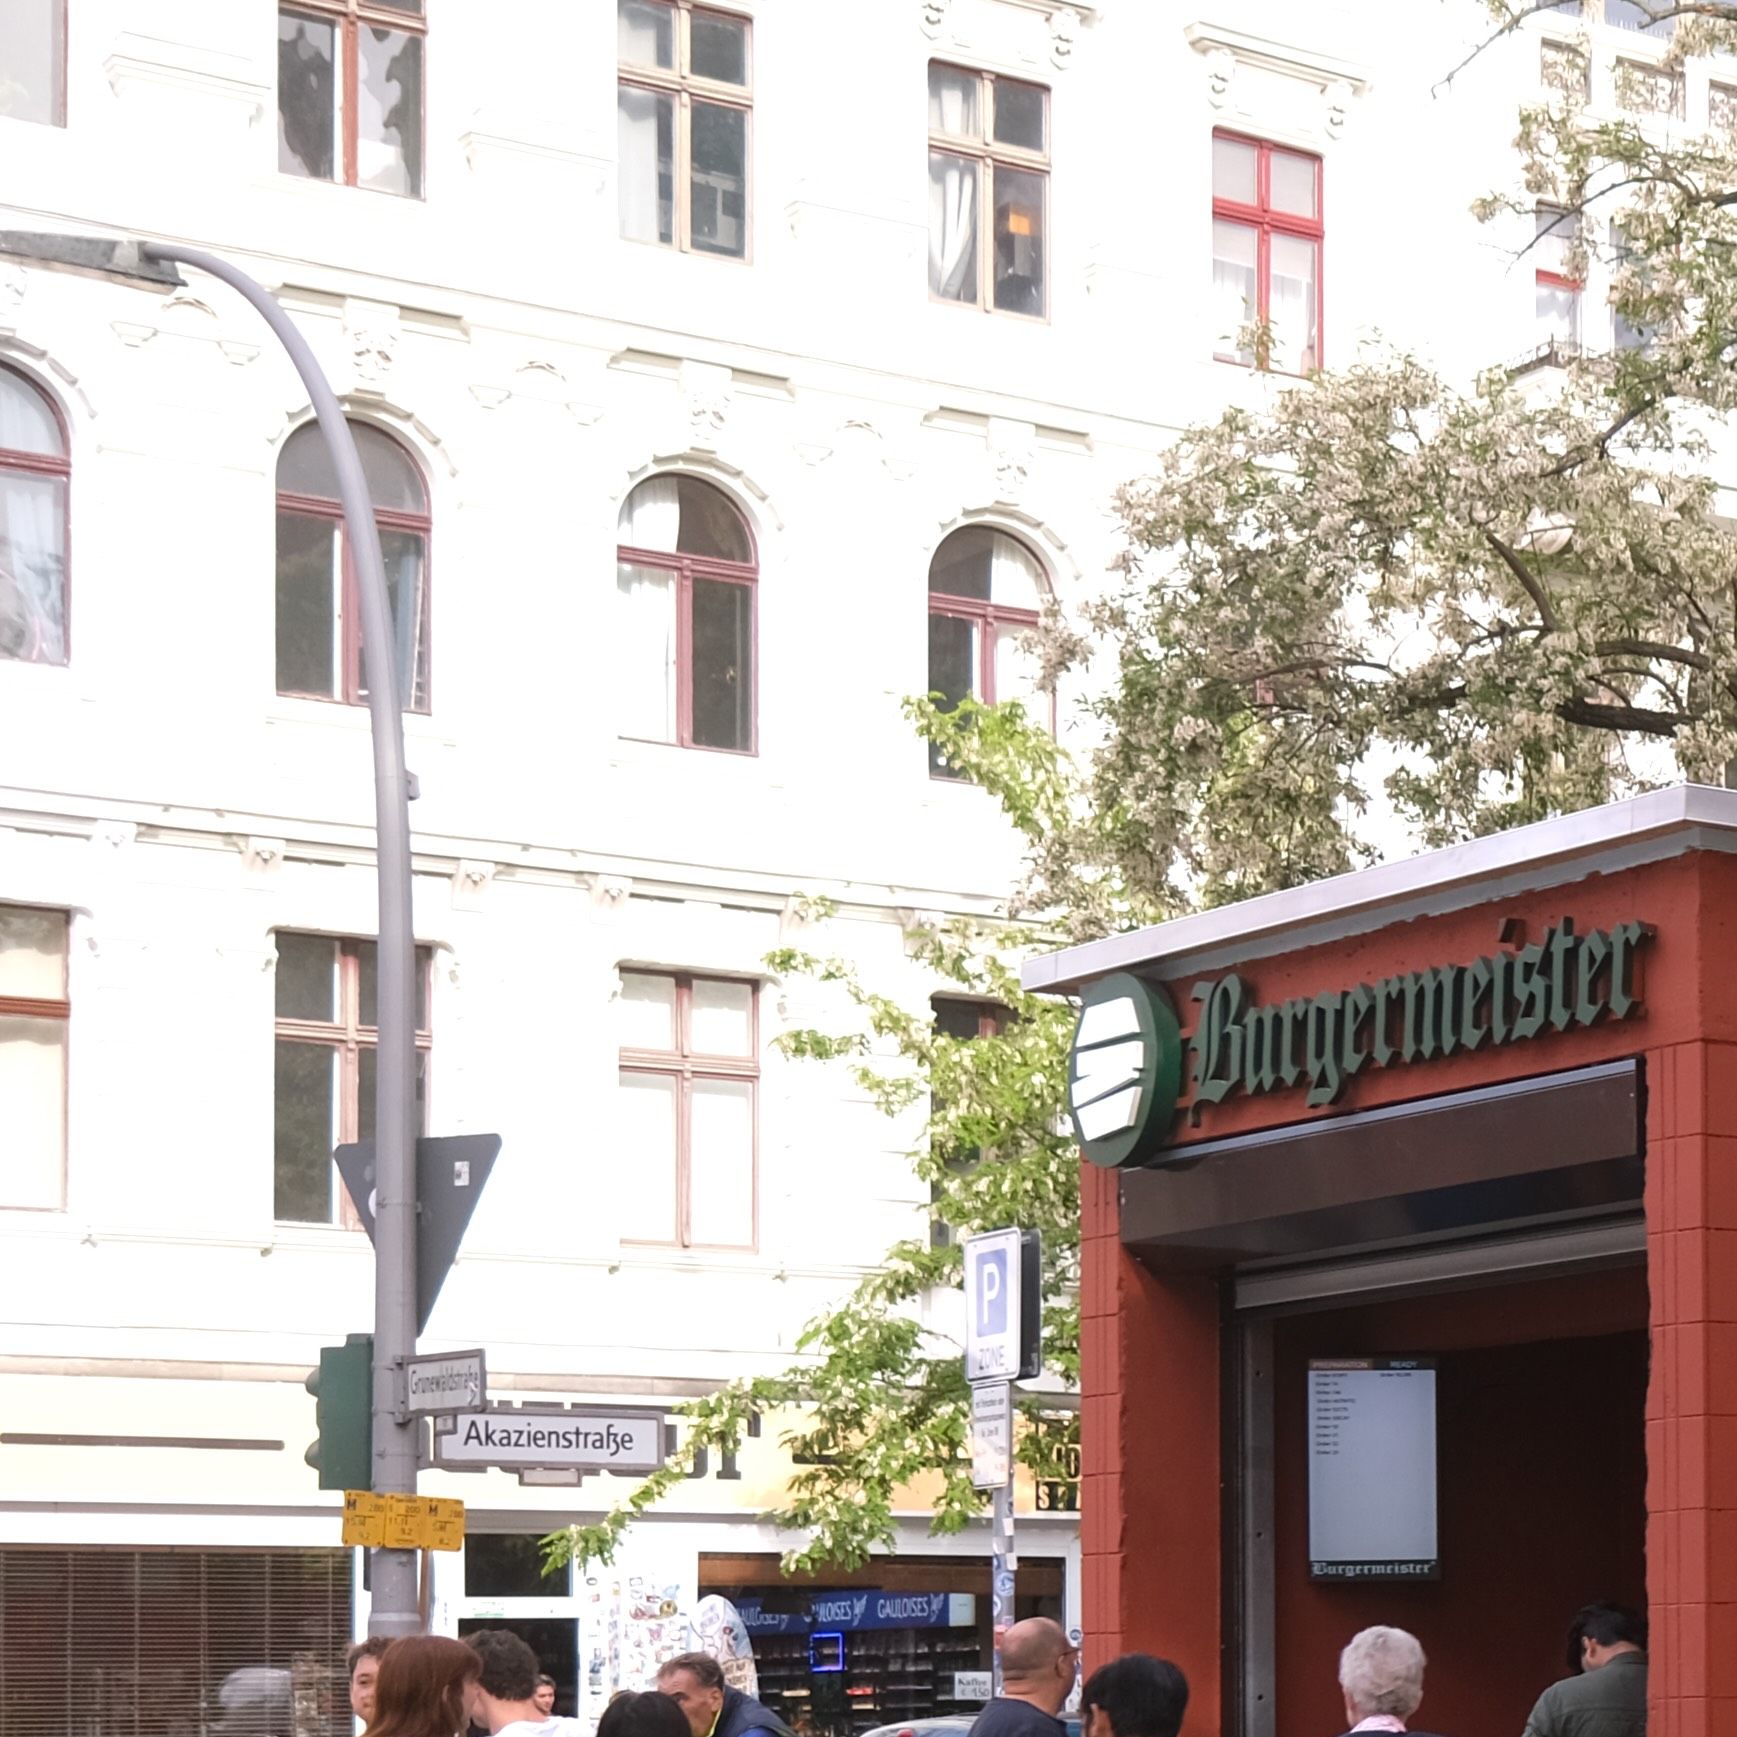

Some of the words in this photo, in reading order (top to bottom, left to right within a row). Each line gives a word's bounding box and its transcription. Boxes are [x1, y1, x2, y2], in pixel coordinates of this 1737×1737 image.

[1190, 917, 1654, 1126] Burgermeister
[983, 1262, 1000, 1324] P
[979, 1345, 1005, 1370] ZONE
[463, 1420, 634, 1456] Akazienstraße
[1311, 1561, 1434, 1577] Burgermeister
[877, 1597, 929, 1619] GAULOISES
